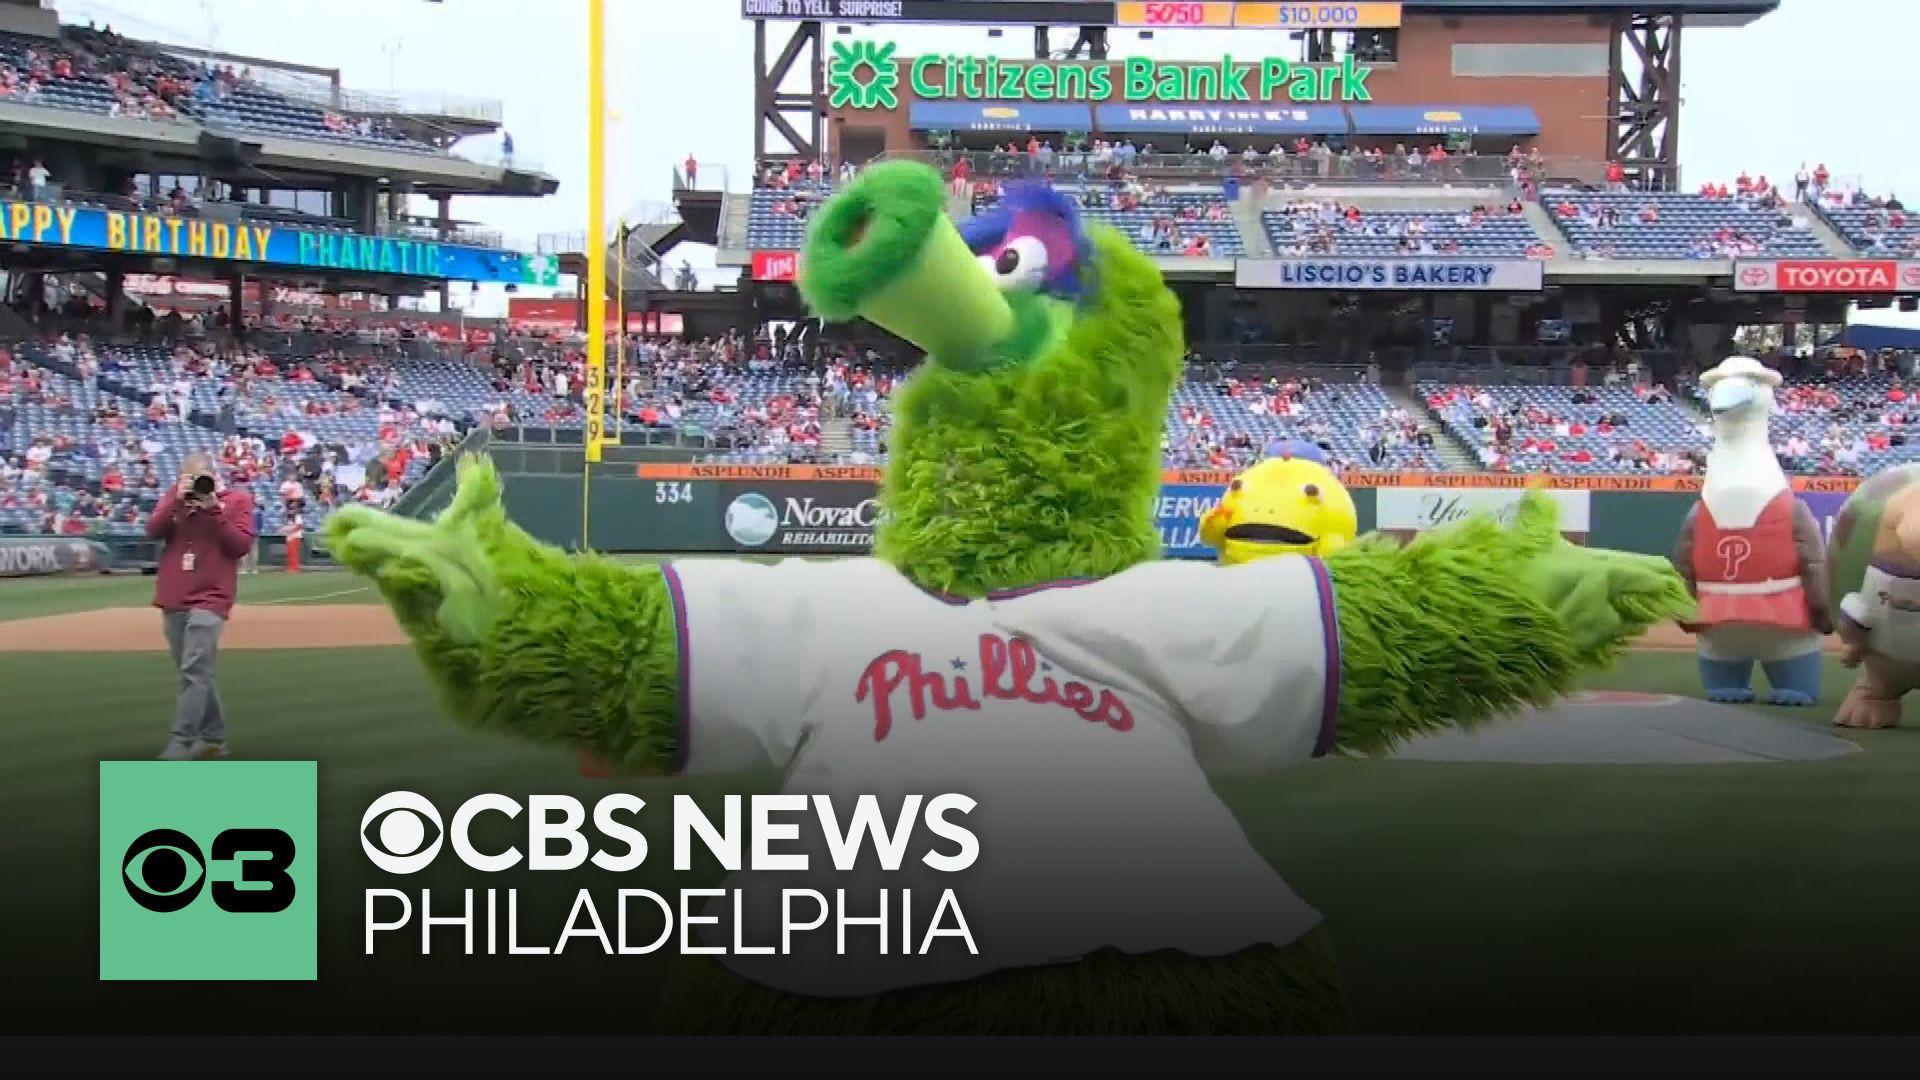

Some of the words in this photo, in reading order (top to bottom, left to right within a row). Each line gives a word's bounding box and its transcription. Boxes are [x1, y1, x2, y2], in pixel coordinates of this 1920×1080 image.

[786, 0, 801, 15] TO
[910, 52, 1112, 101] Citizens
[1122, 52, 1250, 101] Bank
[1259, 52, 1373, 101] Park
[107, 211, 272, 261] BIRTHDAY
[299, 231, 440, 276] PHANATIC
[1281, 265, 1386, 284] LISCIO'S
[1394, 266, 1494, 285] BAKERY
[1784, 267, 1889, 287] TOYOTA
[690, 467, 791, 478] ASPLUNDH
[813, 467, 883, 479] ASPLUN
[1424, 476, 1525, 488] ASPLUNDH
[655, 482, 693, 503] 334
[1549, 477, 1651, 489] ASPLUNDH
[1716, 536, 1751, 580] P
[855, 633, 1135, 742] Phillies
